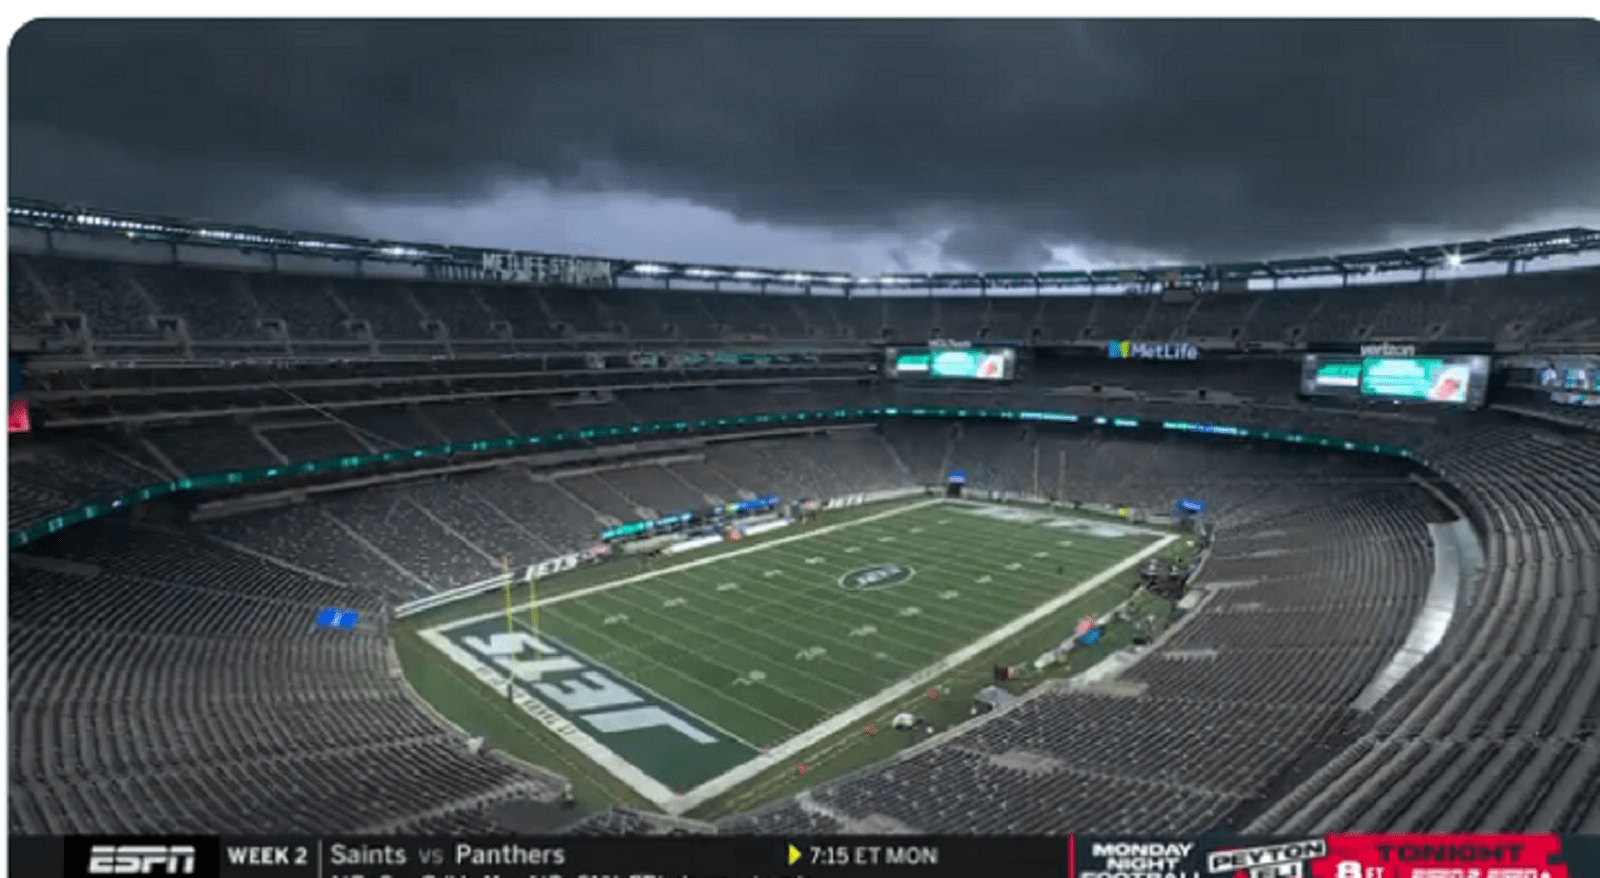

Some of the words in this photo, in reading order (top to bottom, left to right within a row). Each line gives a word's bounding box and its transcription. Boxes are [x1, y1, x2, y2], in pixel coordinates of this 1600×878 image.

[1132, 342, 1197, 360] MetLife
[1360, 340, 1416, 355] verizon
[459, 631, 719, 745] JETS
